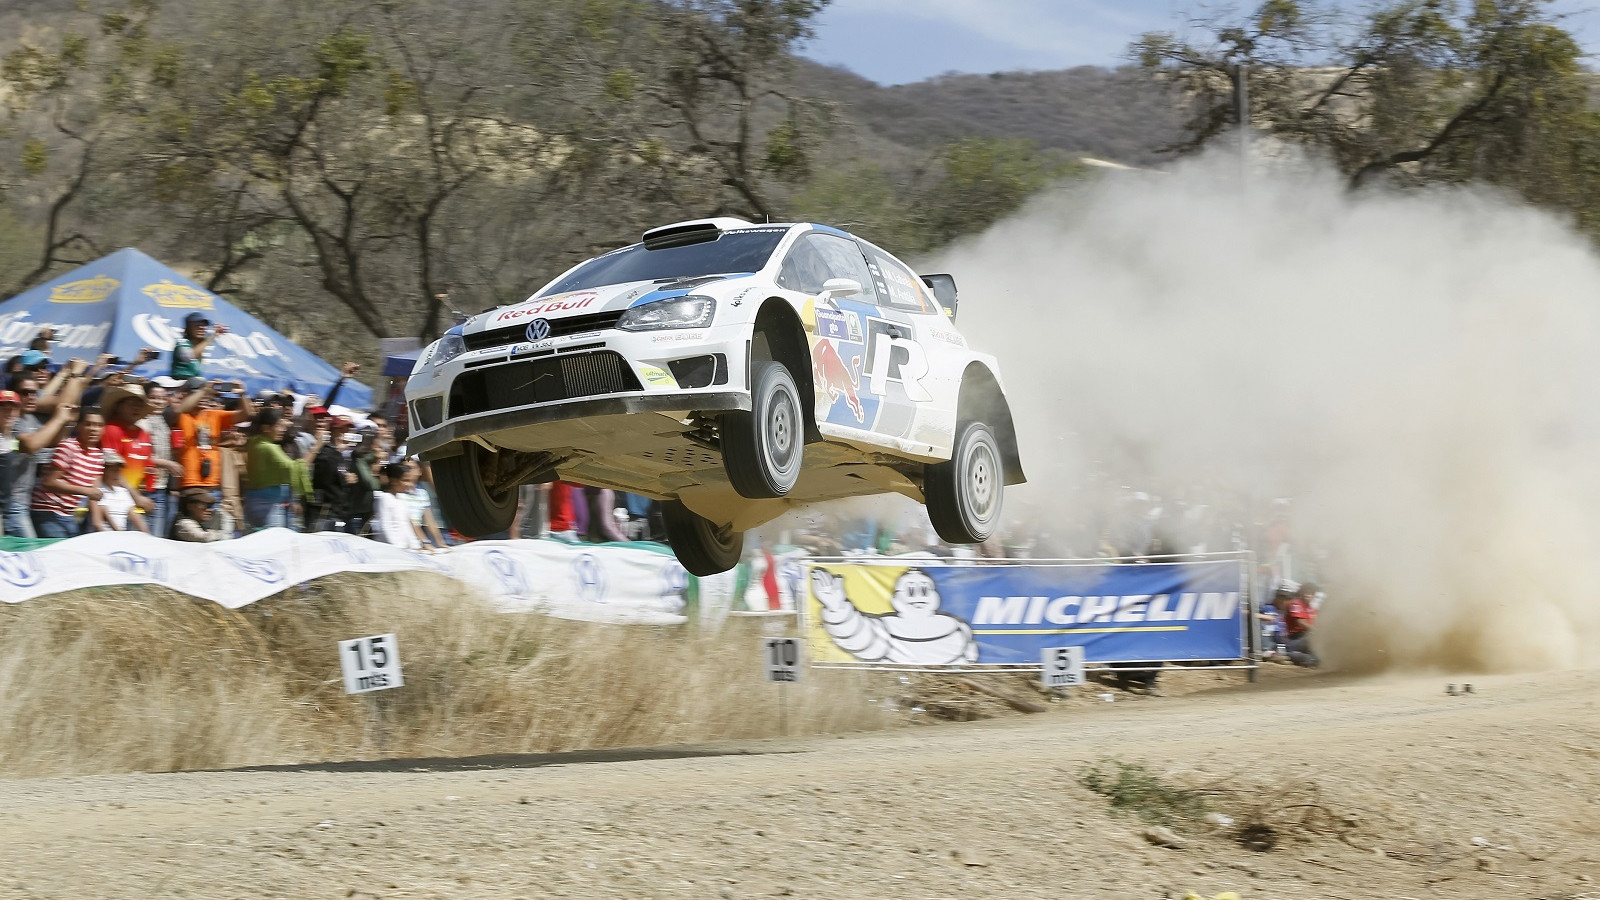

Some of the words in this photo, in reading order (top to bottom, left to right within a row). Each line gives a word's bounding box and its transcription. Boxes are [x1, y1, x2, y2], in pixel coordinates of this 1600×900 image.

[723, 228, 786, 236] Volkswagen
[497, 304, 544, 322] Red
[545, 297, 596, 312] Bull
[870, 332, 934, 402] R
[971, 592, 1239, 625] MICHELIN
[350, 637, 388, 671] 15
[766, 639, 797, 666] 10
[1054, 649, 1071, 671] 5
